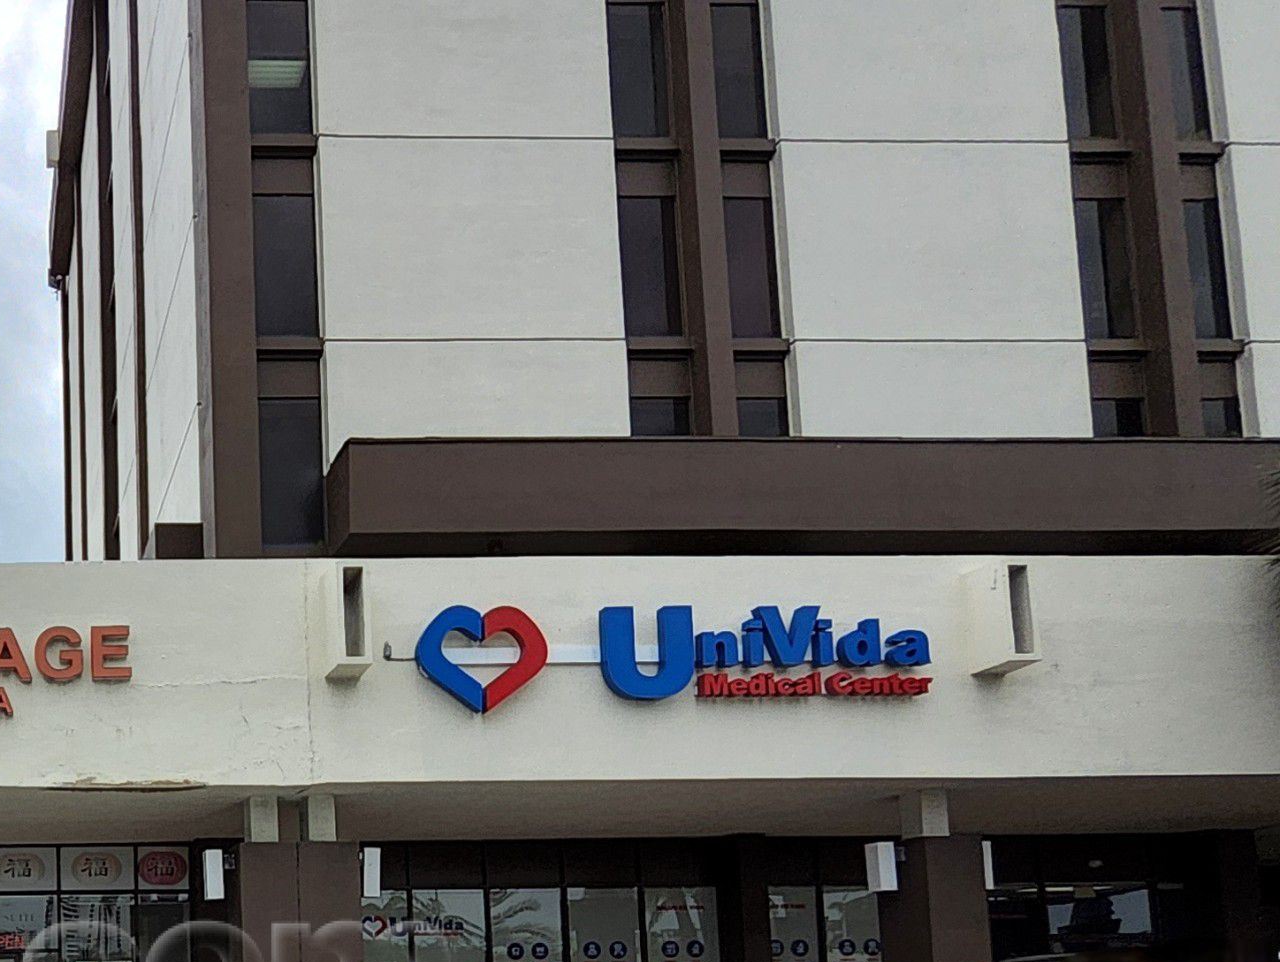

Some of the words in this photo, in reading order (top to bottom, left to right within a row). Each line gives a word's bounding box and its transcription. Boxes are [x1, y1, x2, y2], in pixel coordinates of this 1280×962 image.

[598, 605, 931, 700] UniVida
[695, 673, 821, 698] Medical
[823, 673, 932, 697] Center
